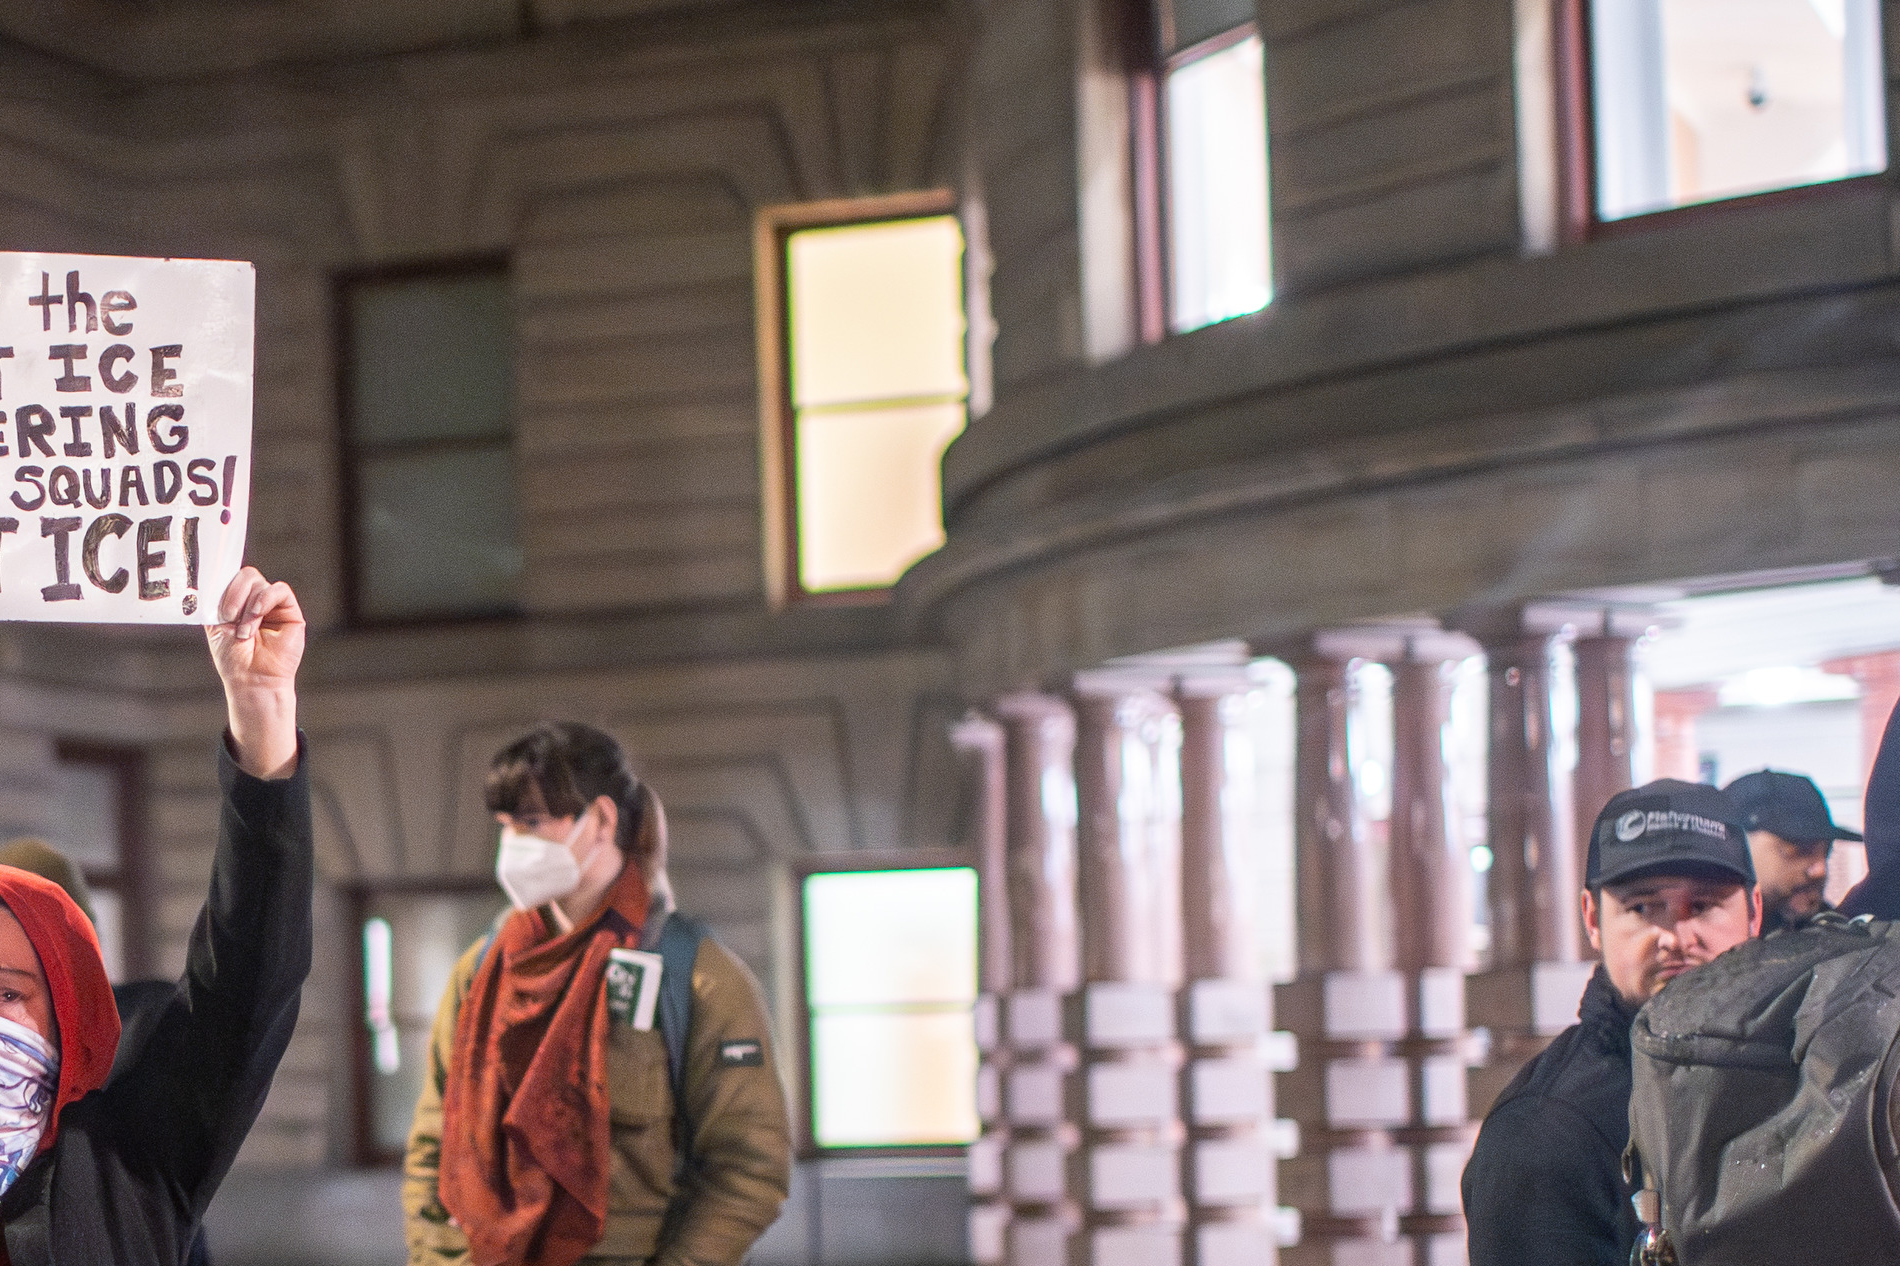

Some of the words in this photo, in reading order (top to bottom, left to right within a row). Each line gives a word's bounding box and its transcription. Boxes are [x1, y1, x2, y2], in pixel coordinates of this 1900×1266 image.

[28, 269, 138, 336] the
[49, 343, 184, 398] ICE
[9, 455, 238, 525] SQUADS!
[39, 512, 200, 616] ICE!
